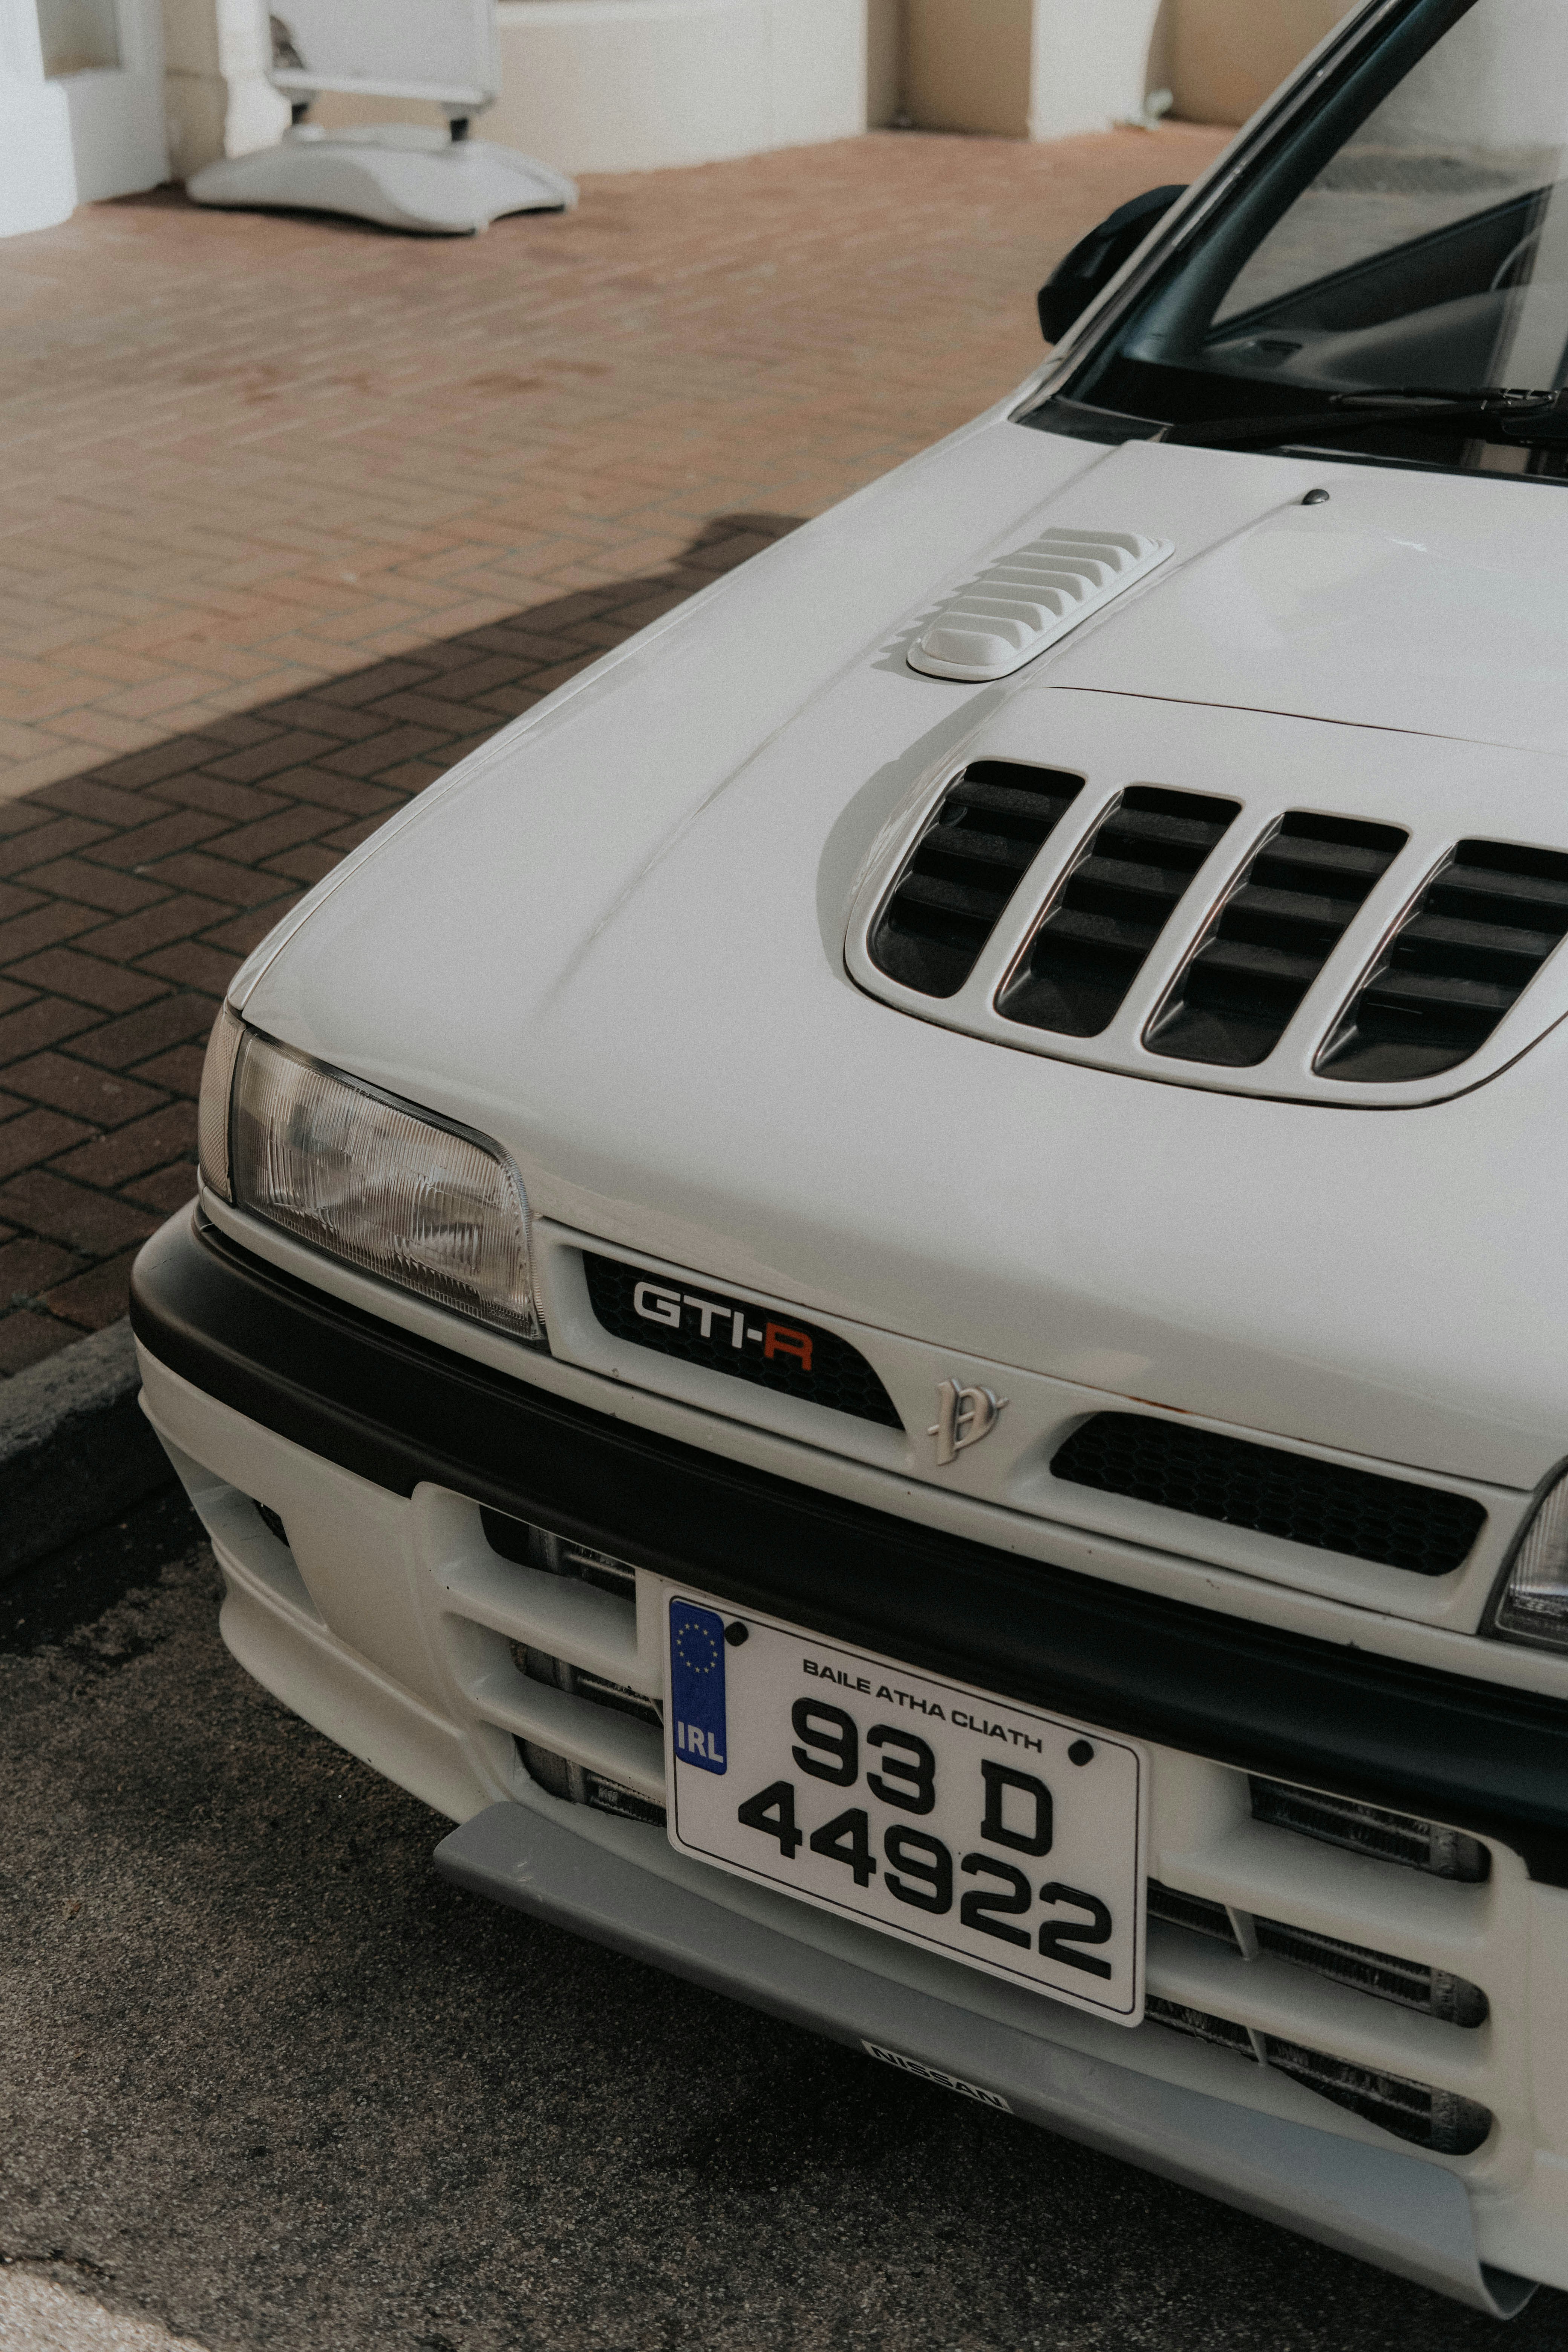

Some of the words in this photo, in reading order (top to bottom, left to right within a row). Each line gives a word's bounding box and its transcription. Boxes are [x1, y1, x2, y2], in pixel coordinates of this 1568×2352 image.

[634, 1282, 813, 1370] GTI-R
[678, 1721, 724, 1763] IRL
[803, 1659, 871, 1695] BAILE
[876, 1685, 946, 1721] ATHA
[951, 1710, 1043, 1753] CLIATH
[792, 1697, 936, 1815] 93
[981, 1759, 1053, 1857] D
[738, 1781, 1112, 1980] 44922
[871, 2046, 1004, 2108] NISSAN
